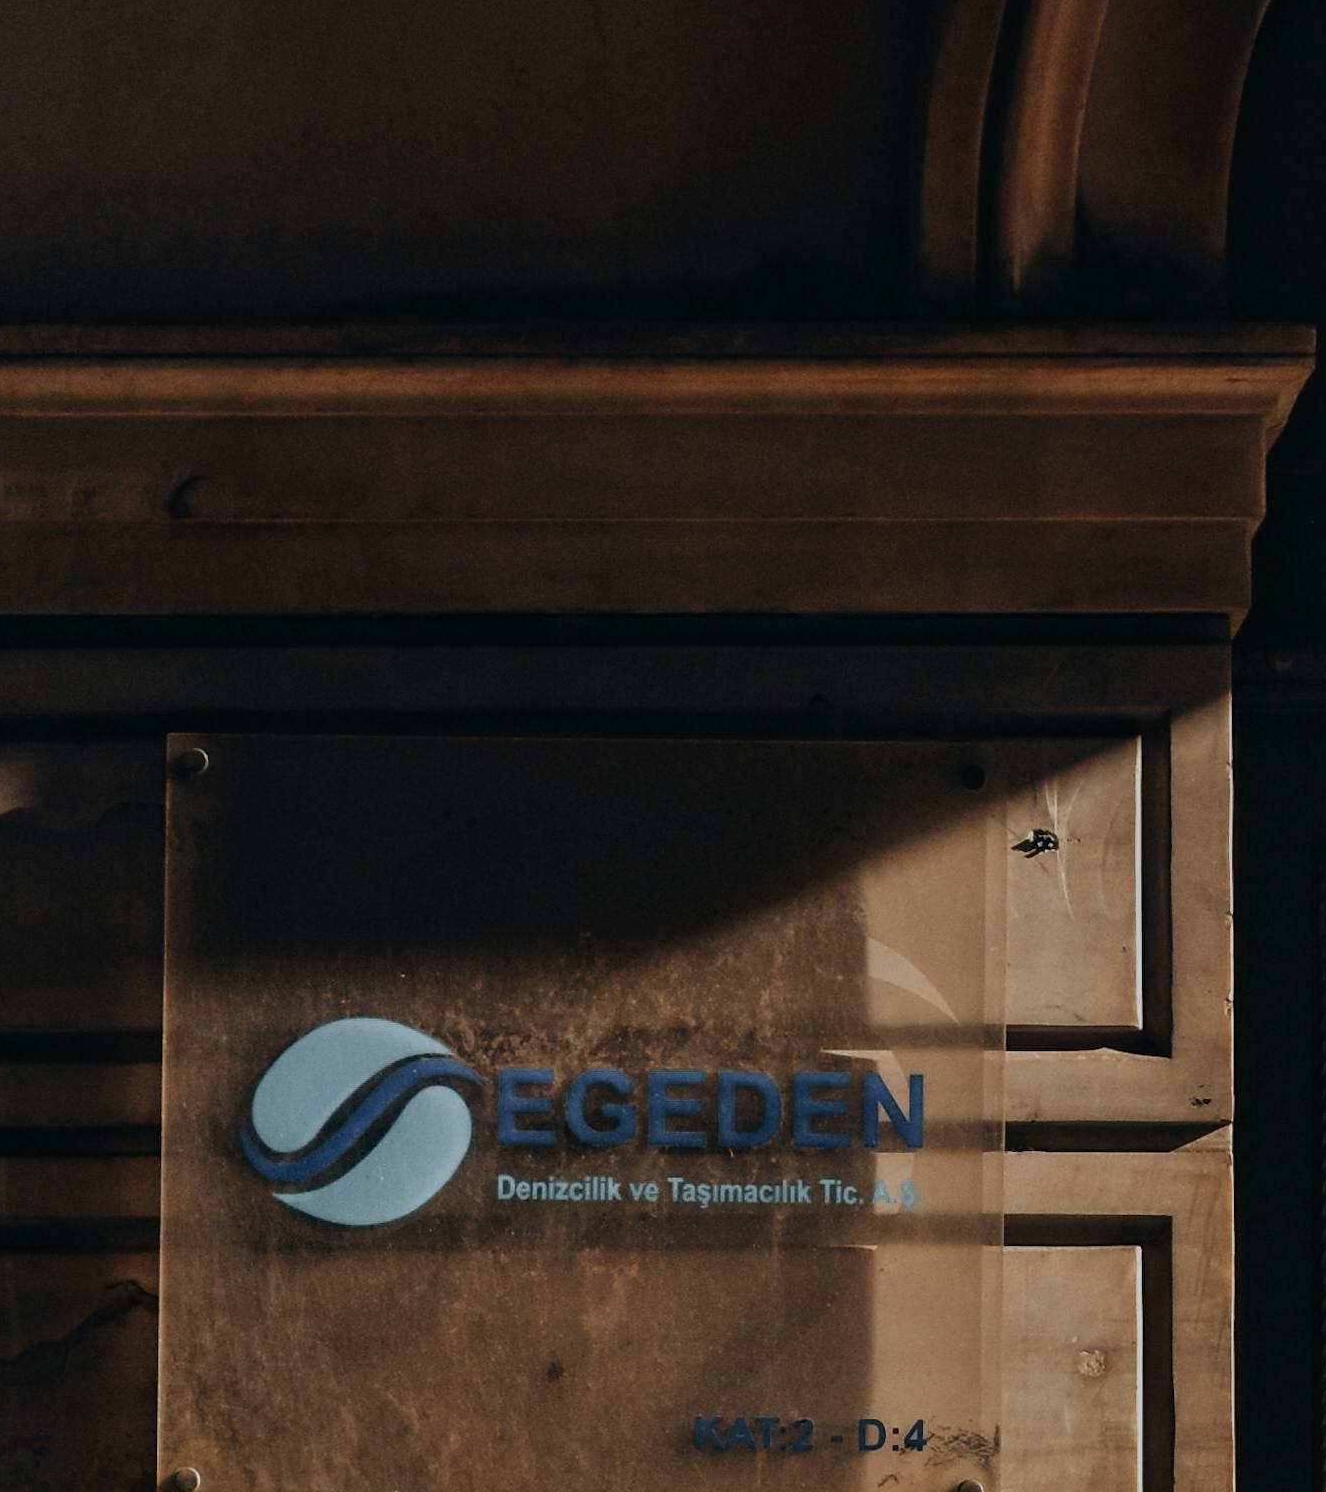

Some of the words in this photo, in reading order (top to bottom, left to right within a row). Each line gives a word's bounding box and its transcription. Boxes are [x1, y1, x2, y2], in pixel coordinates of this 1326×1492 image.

[497, 1067, 925, 1150] EGEDEN
[497, 1174, 622, 1201] Denizcilik
[629, 1180, 660, 1202] ve
[668, 1177, 811, 1209] Taşımacılık
[819, 1178, 864, 1205] Tic.
[693, 1414, 815, 1452] KAT:2
[858, 1418, 926, 1452] D:4
